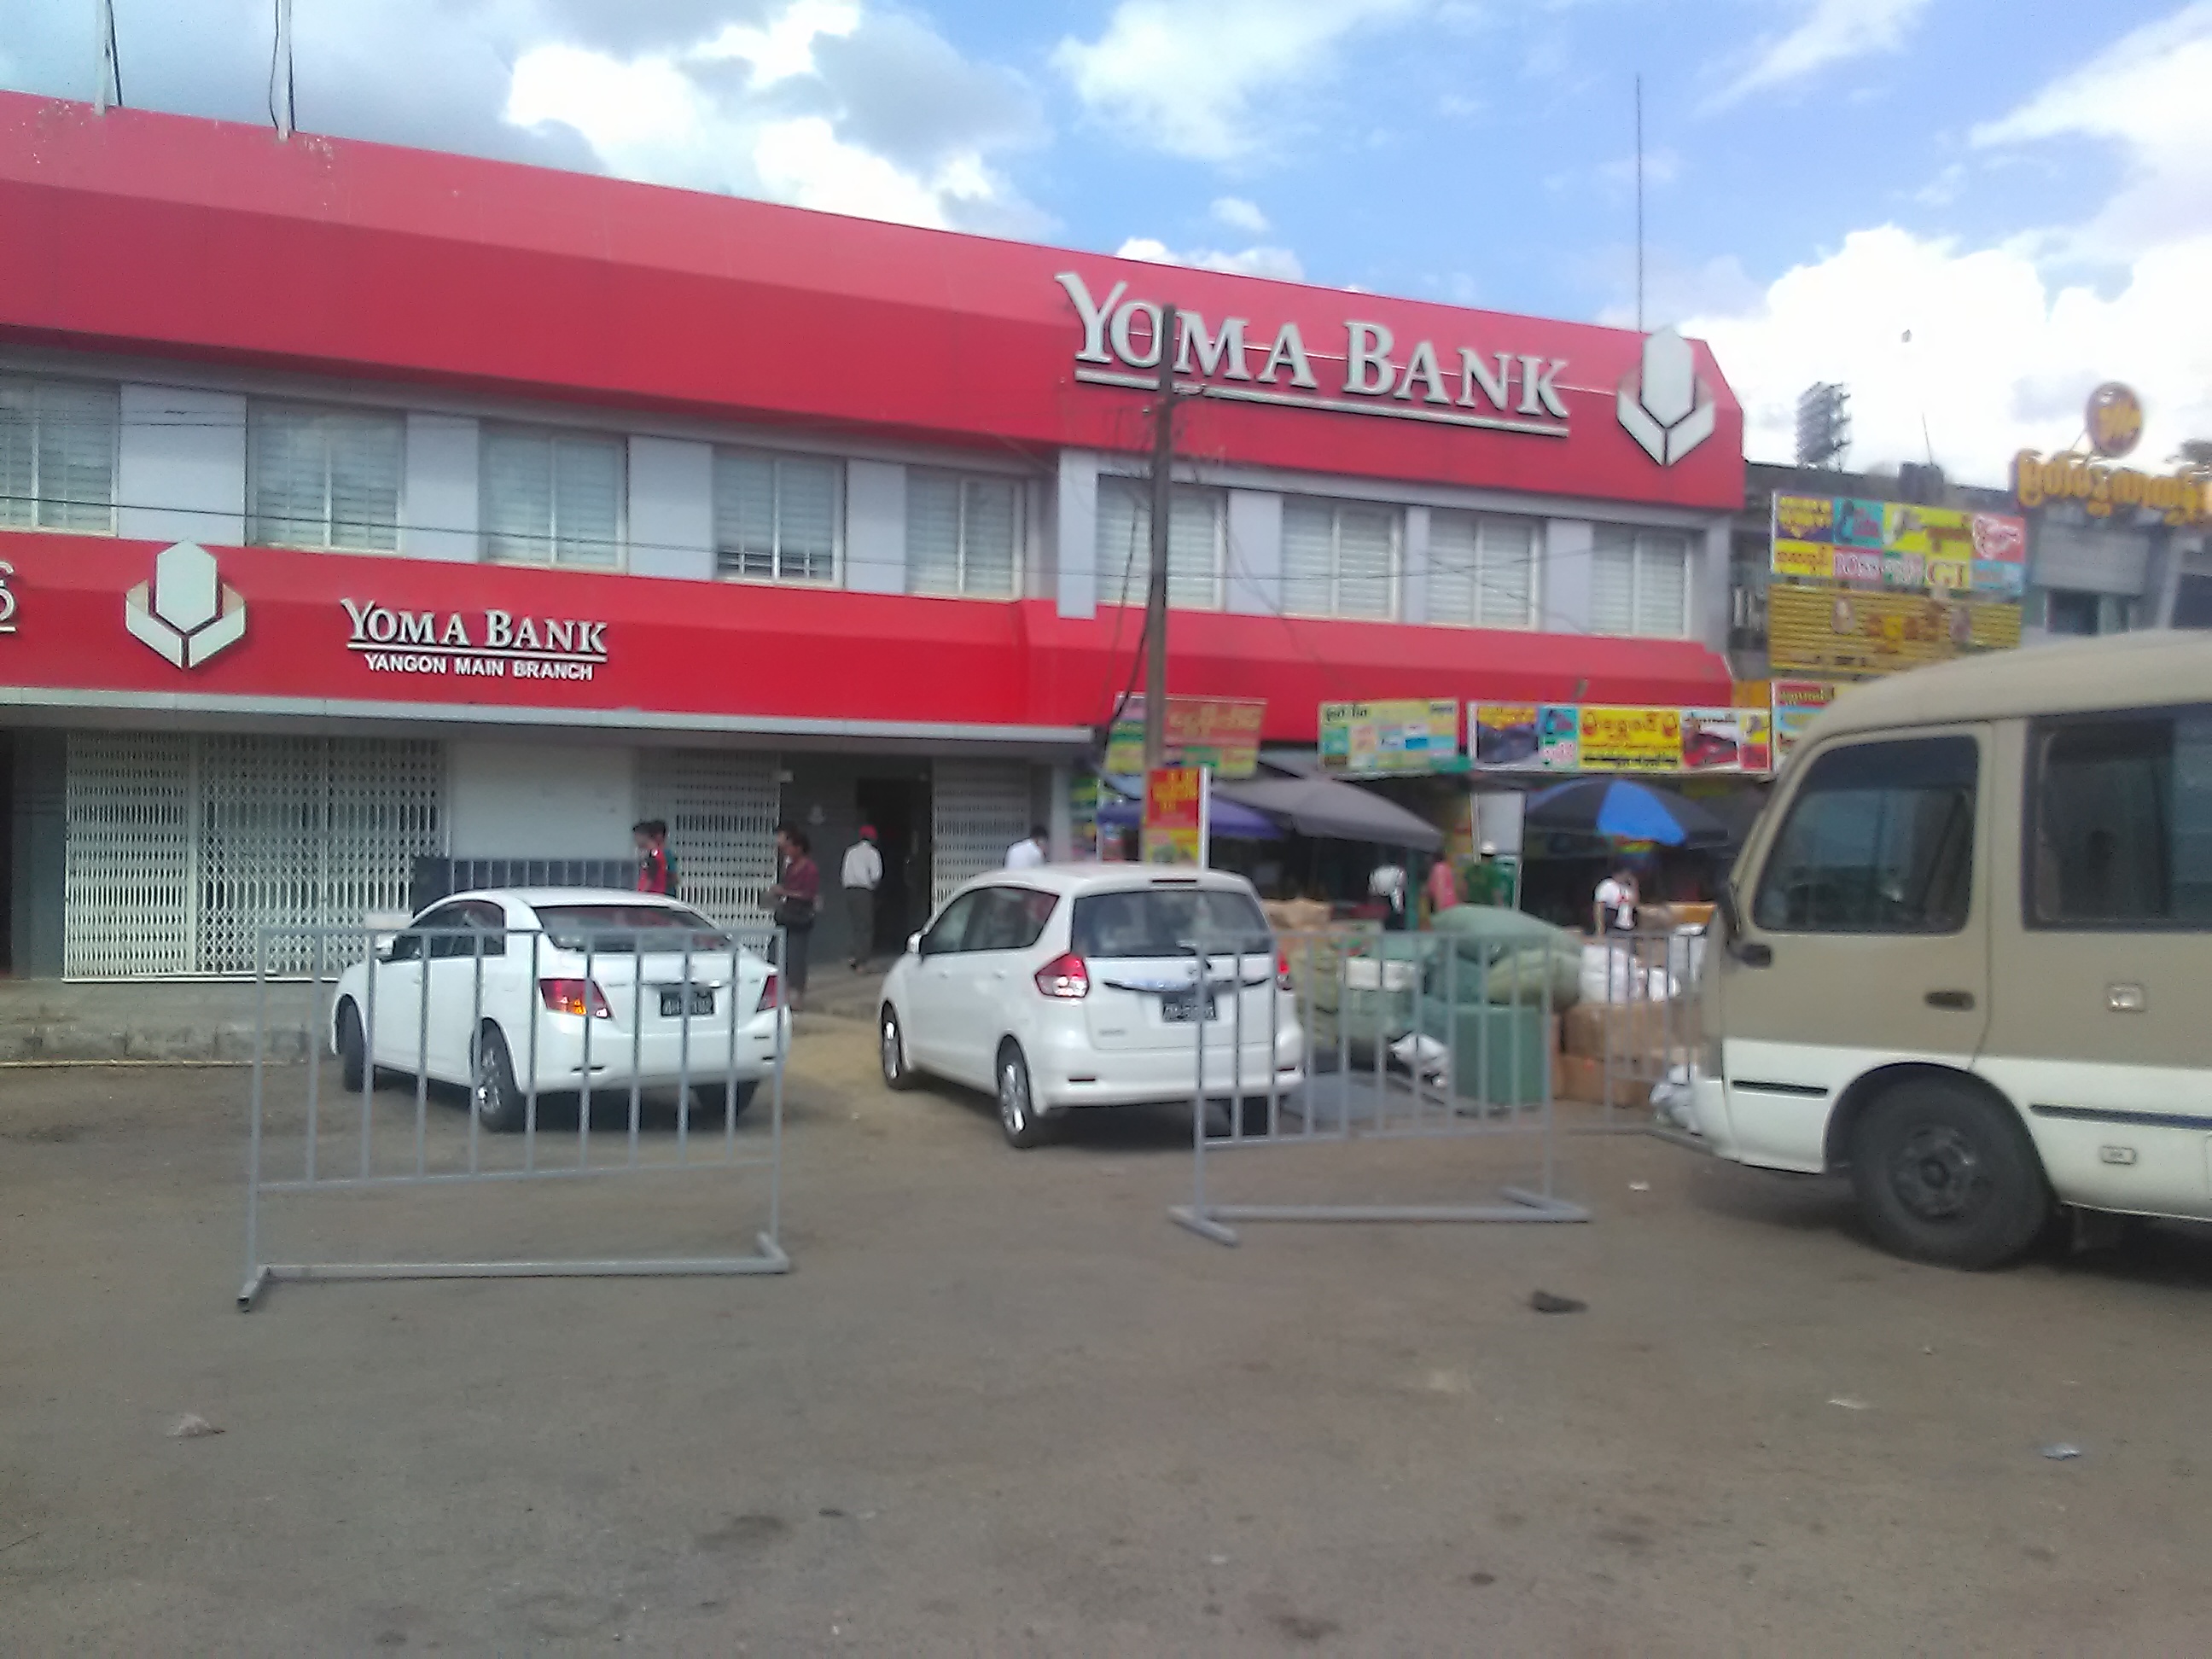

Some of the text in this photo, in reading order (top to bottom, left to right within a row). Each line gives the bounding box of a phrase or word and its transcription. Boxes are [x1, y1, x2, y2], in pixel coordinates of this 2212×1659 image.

[1054, 272, 1569, 418] YOMA BANK
[341, 597, 608, 654] YOMA BANK
[364, 654, 592, 680] YANGON MAIN BRANCH
